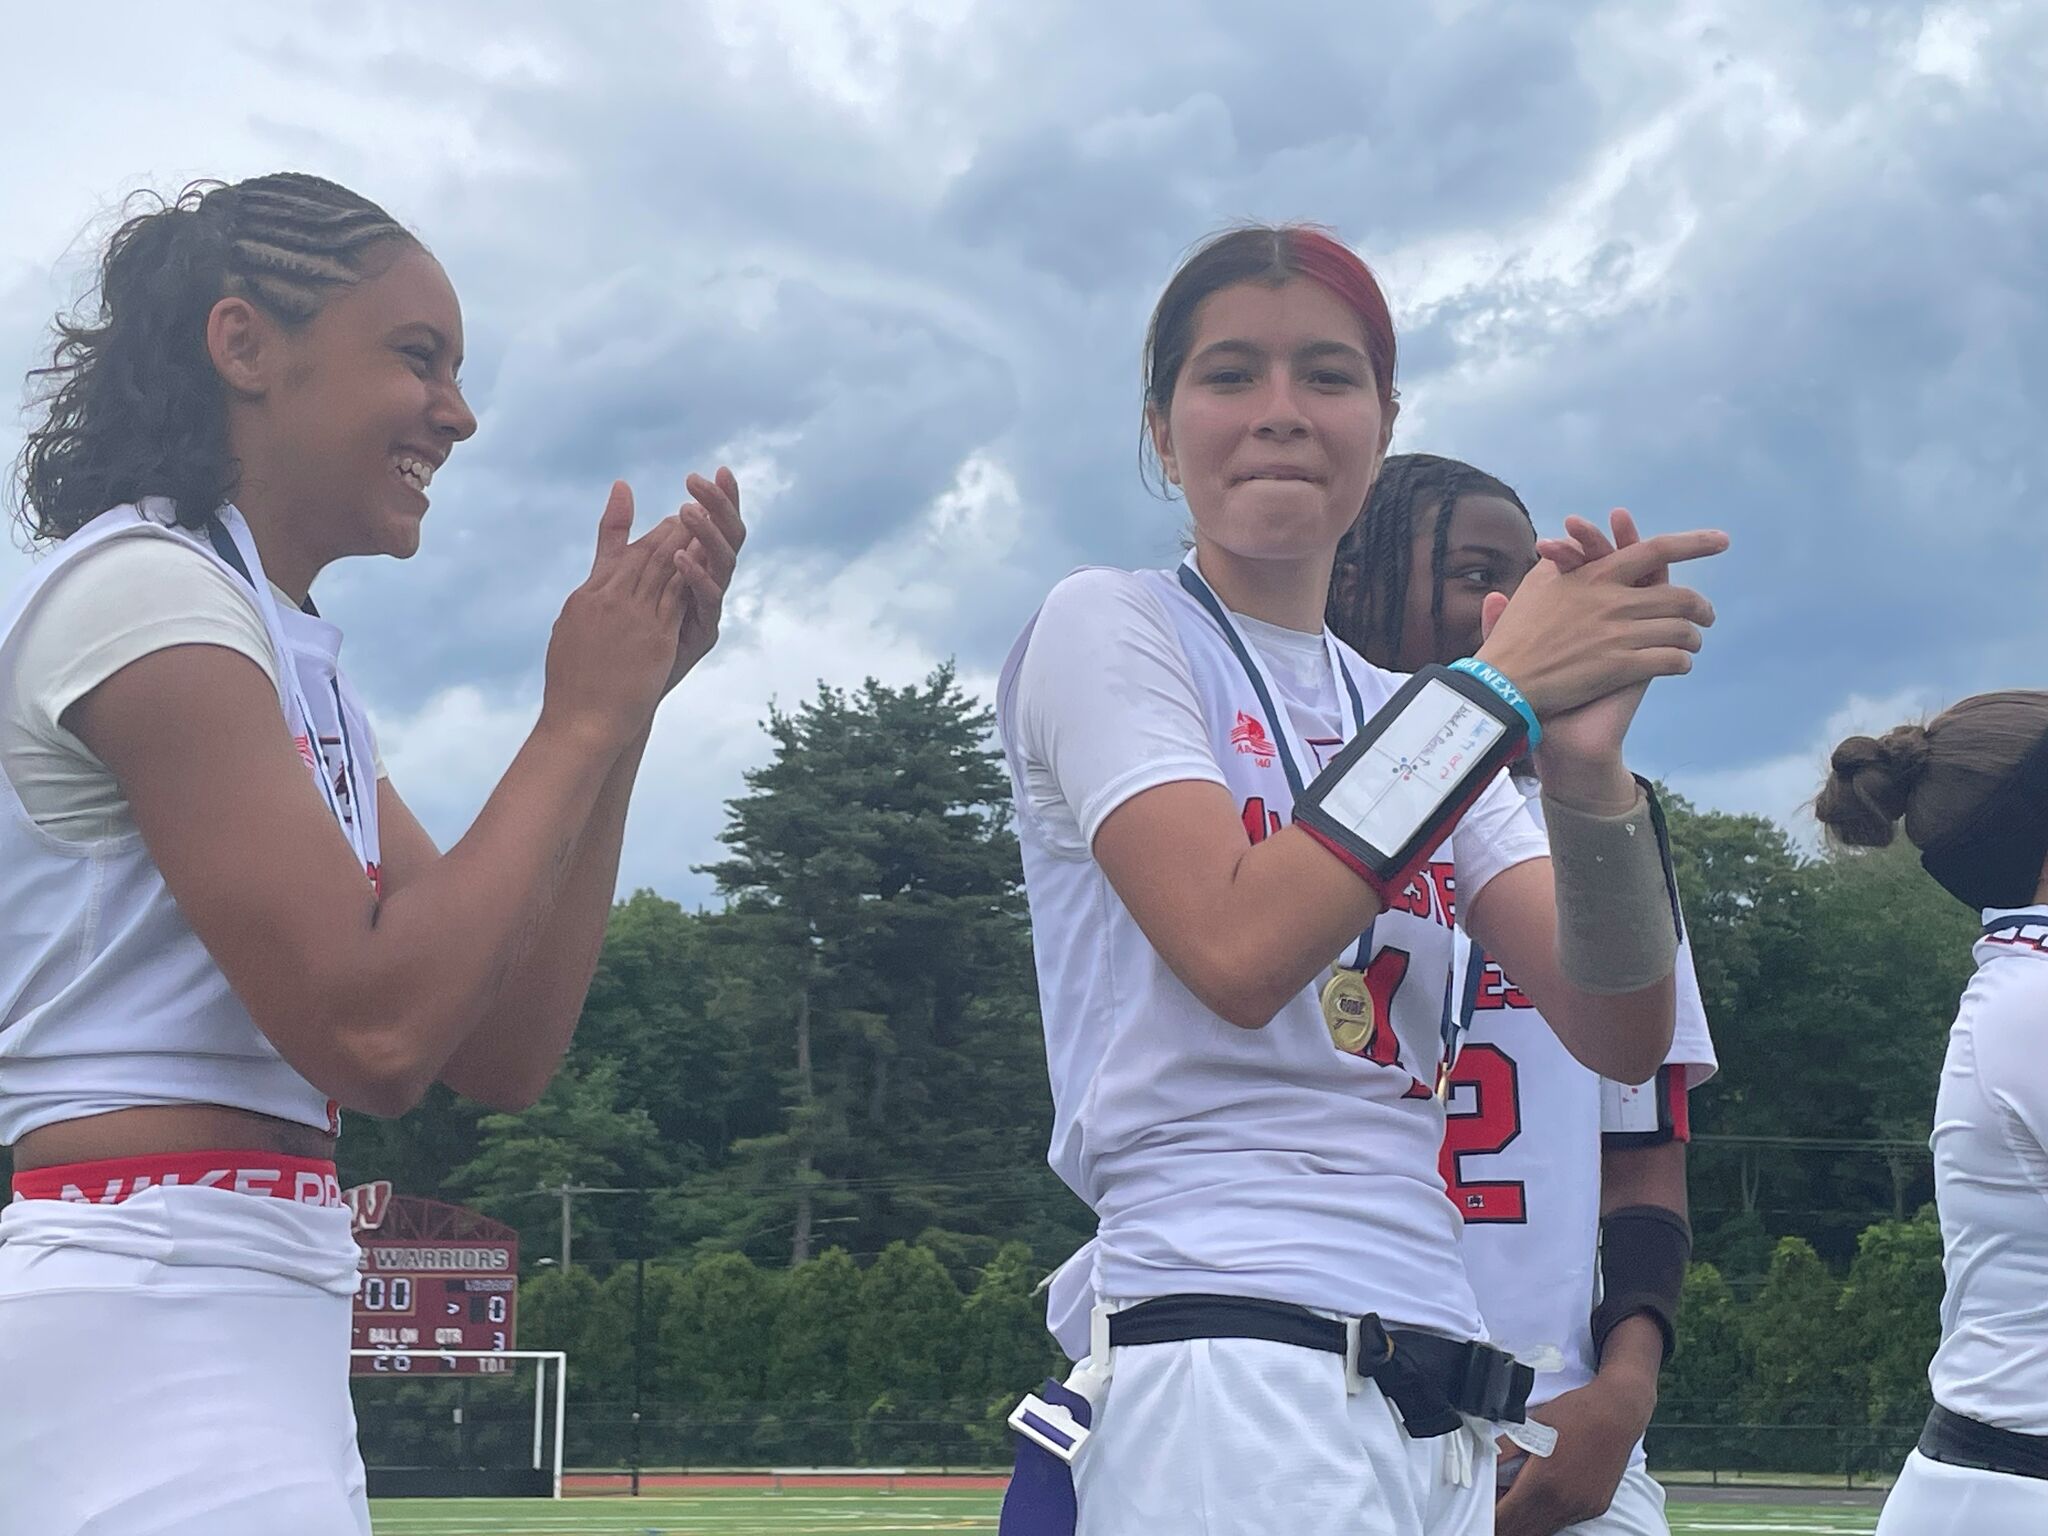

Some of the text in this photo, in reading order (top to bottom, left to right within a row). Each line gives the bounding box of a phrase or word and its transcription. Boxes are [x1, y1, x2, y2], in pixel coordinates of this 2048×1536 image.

[1479, 668, 1524, 706] NEXT
[373, 1248, 510, 1270] WARRIORS
[488, 1296, 506, 1323] 0
